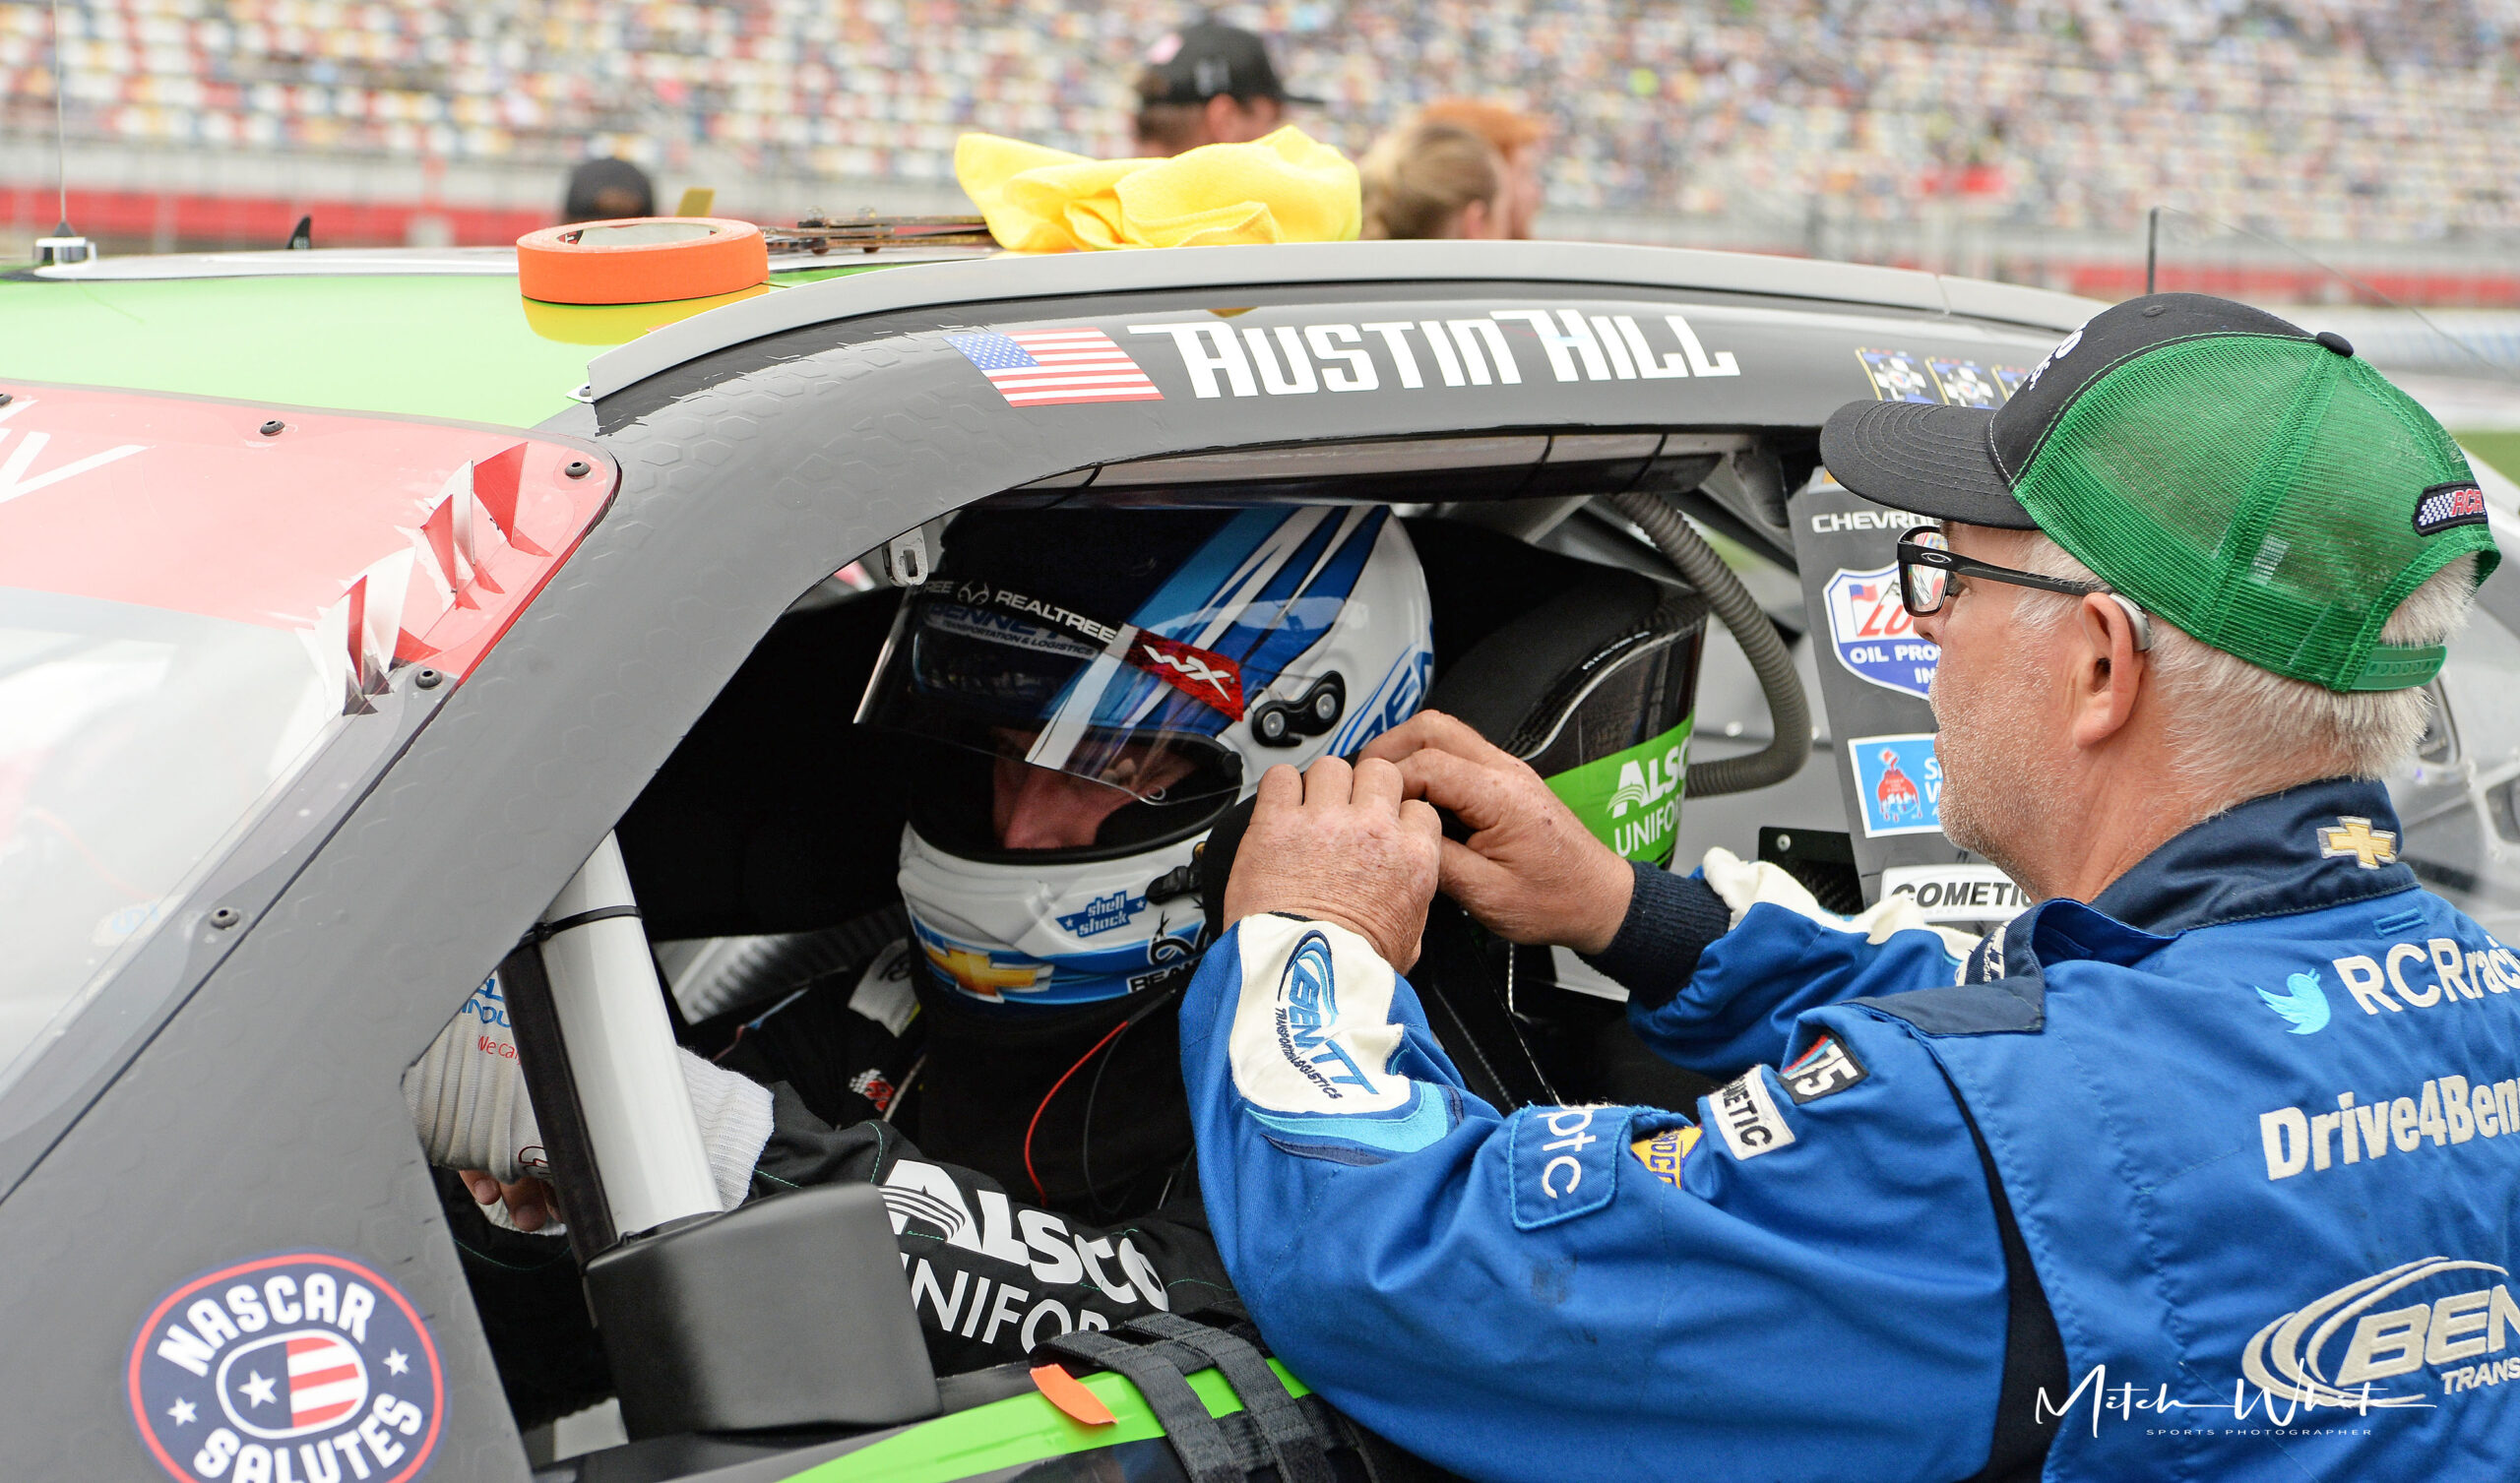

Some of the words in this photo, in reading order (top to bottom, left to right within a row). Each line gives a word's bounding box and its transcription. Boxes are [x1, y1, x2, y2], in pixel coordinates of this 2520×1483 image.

[1128, 318, 1522, 400] AUSTIN
[1491, 308, 1741, 382] HILL
[942, 620, 1021, 644] TRANSPORTATION
[1032, 638, 1094, 657] LOGISTICS
[994, 589, 1119, 644] REALTREE
[1858, 603, 1918, 638] LU
[1849, 645, 1889, 664] OIL
[1893, 644, 1942, 662] PRO
[1078, 909, 1128, 936] shock
[1087, 894, 1125, 917] shell
[157, 1271, 377, 1378] NASCAR
[900, 1252, 1110, 1355] NIFO
[193, 1392, 424, 1483] SALUTES
